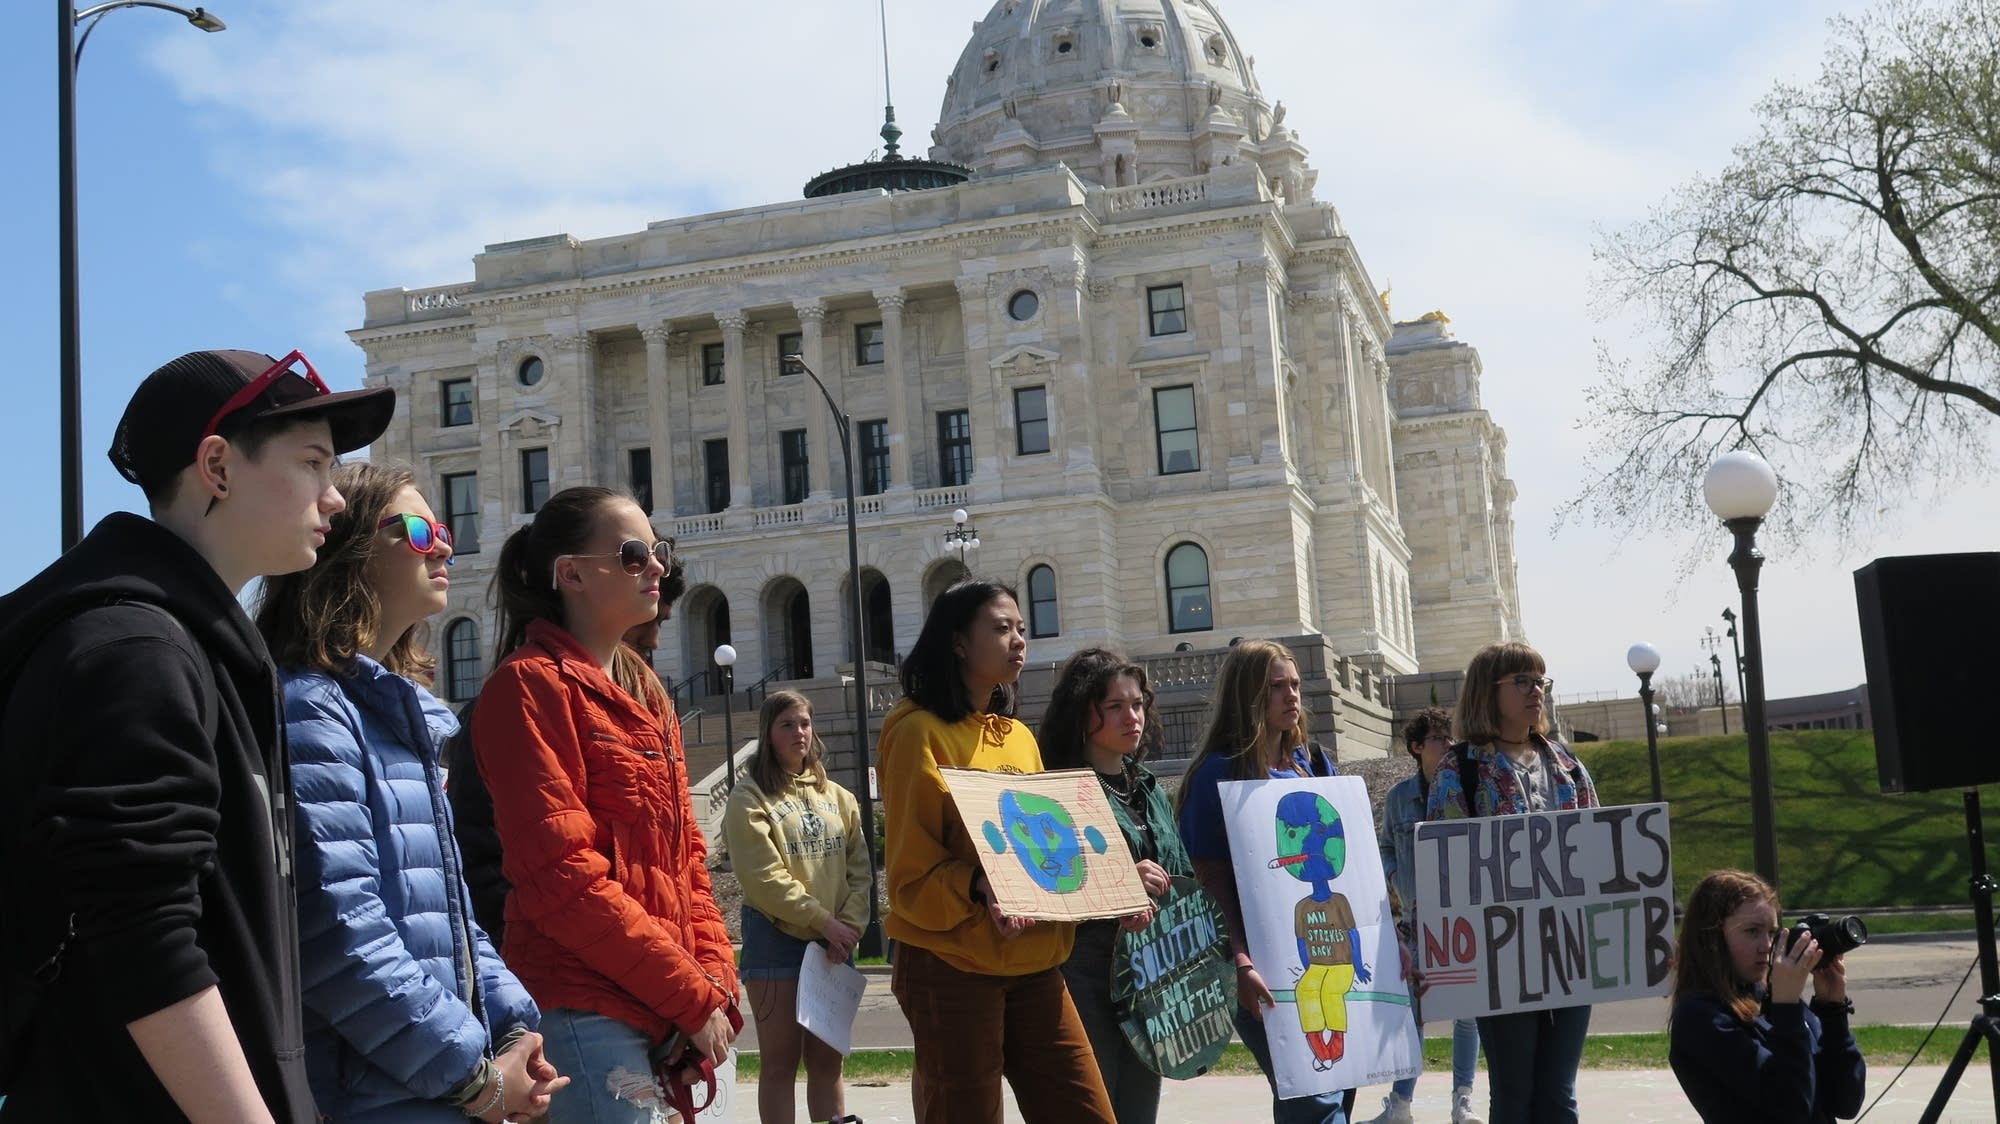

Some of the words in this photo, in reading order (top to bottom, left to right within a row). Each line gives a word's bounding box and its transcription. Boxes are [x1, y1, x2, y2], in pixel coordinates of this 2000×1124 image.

[1417, 812, 1586, 908] THERE
[1593, 807, 1670, 895] IS
[1125, 917, 1157, 954] PART
[1159, 904, 1176, 936] OF
[1177, 889, 1209, 922] THE
[1129, 911, 1217, 991] SOLUTION
[1308, 928, 1344, 943] STRIKES
[1311, 945, 1332, 957] BACK
[1423, 916, 1477, 968] NO
[1483, 897, 1641, 1010] PLANET
[1643, 896, 1674, 987] B
[1146, 1006, 1178, 1043] PART
[1179, 994, 1195, 1024] OF
[1197, 978, 1225, 1012] THE
[1162, 974, 1190, 1010] NOT
[1154, 1004, 1235, 1074] POLLUTION
